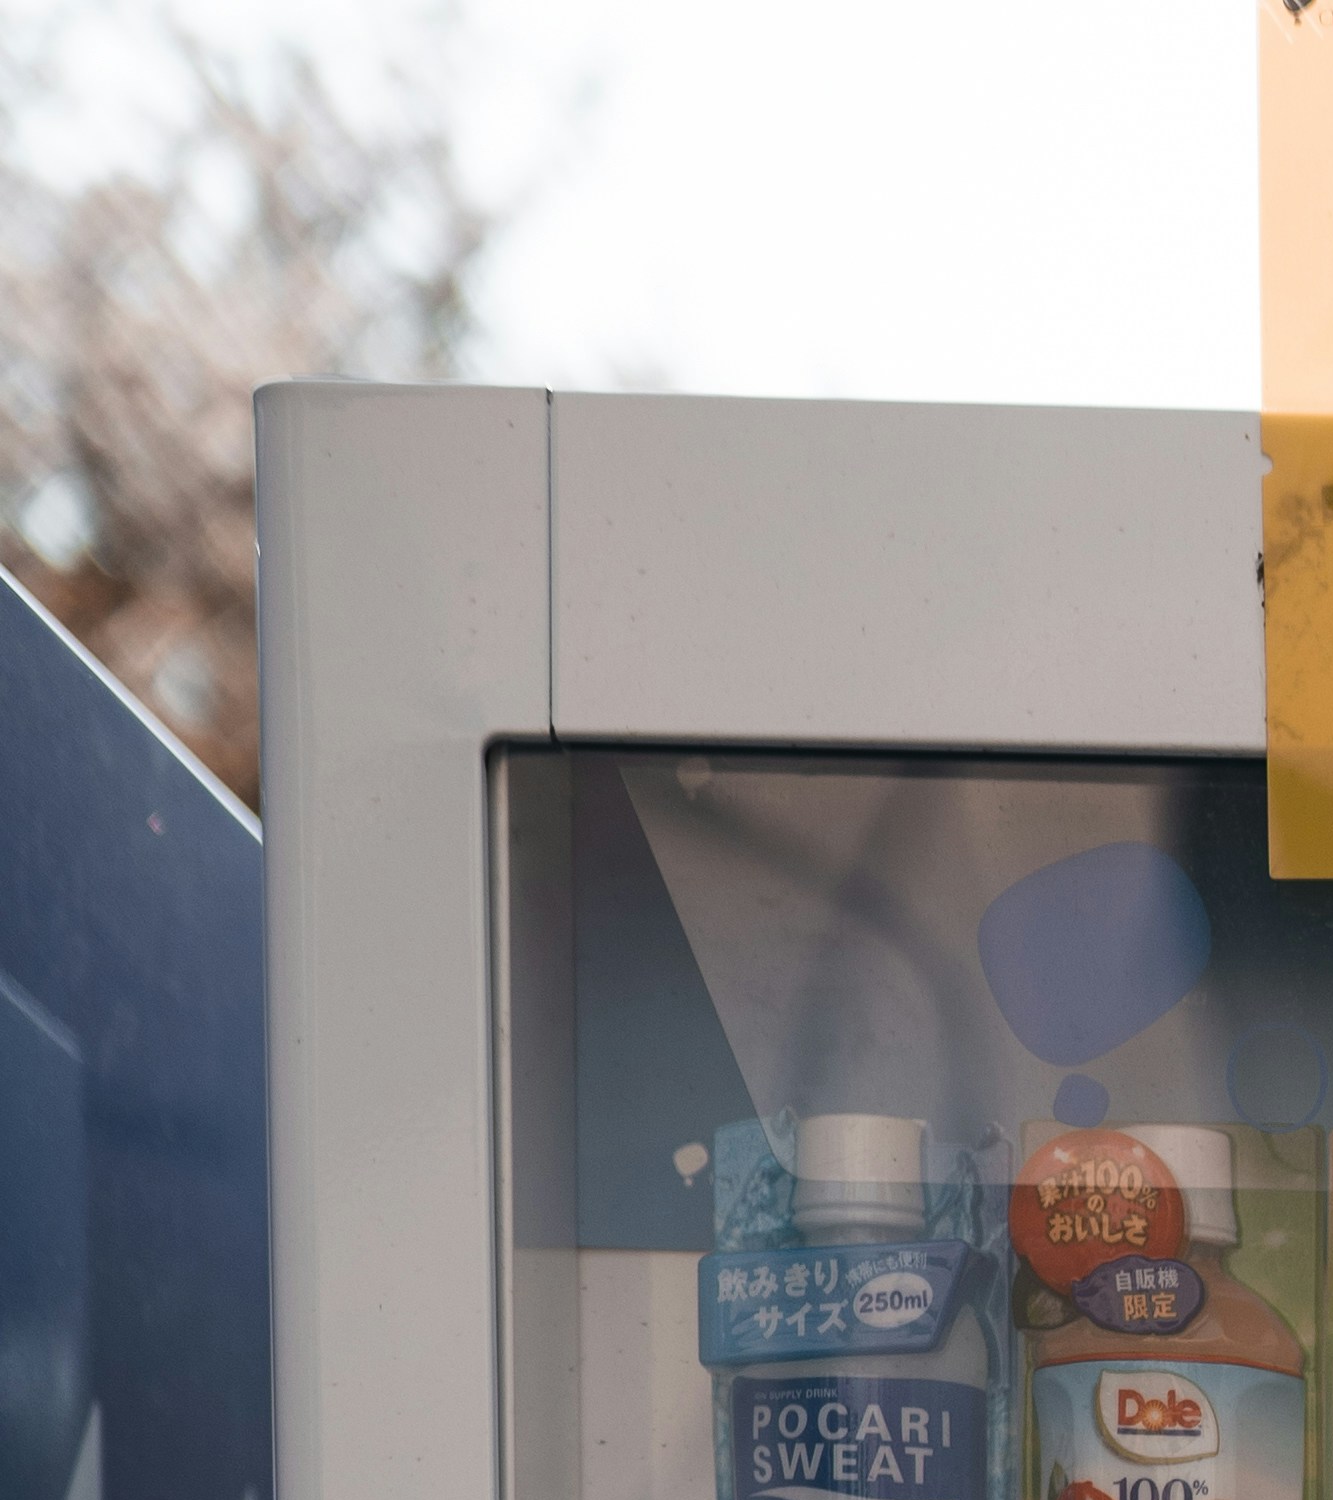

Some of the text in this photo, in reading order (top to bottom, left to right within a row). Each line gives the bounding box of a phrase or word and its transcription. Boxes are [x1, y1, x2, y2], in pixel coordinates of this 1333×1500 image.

[1049, 1214, 1147, 1246] おいしさ
[1116, 1267, 1178, 1291] 自販機
[860, 1291, 926, 1312] 250ml
[1124, 1295, 1176, 1320] 限定
[754, 1300, 848, 1339] サイズ
[753, 1403, 950, 1447] POCARI
[1118, 1390, 1201, 1430] Dole
[753, 1444, 933, 1484] SWEAT
